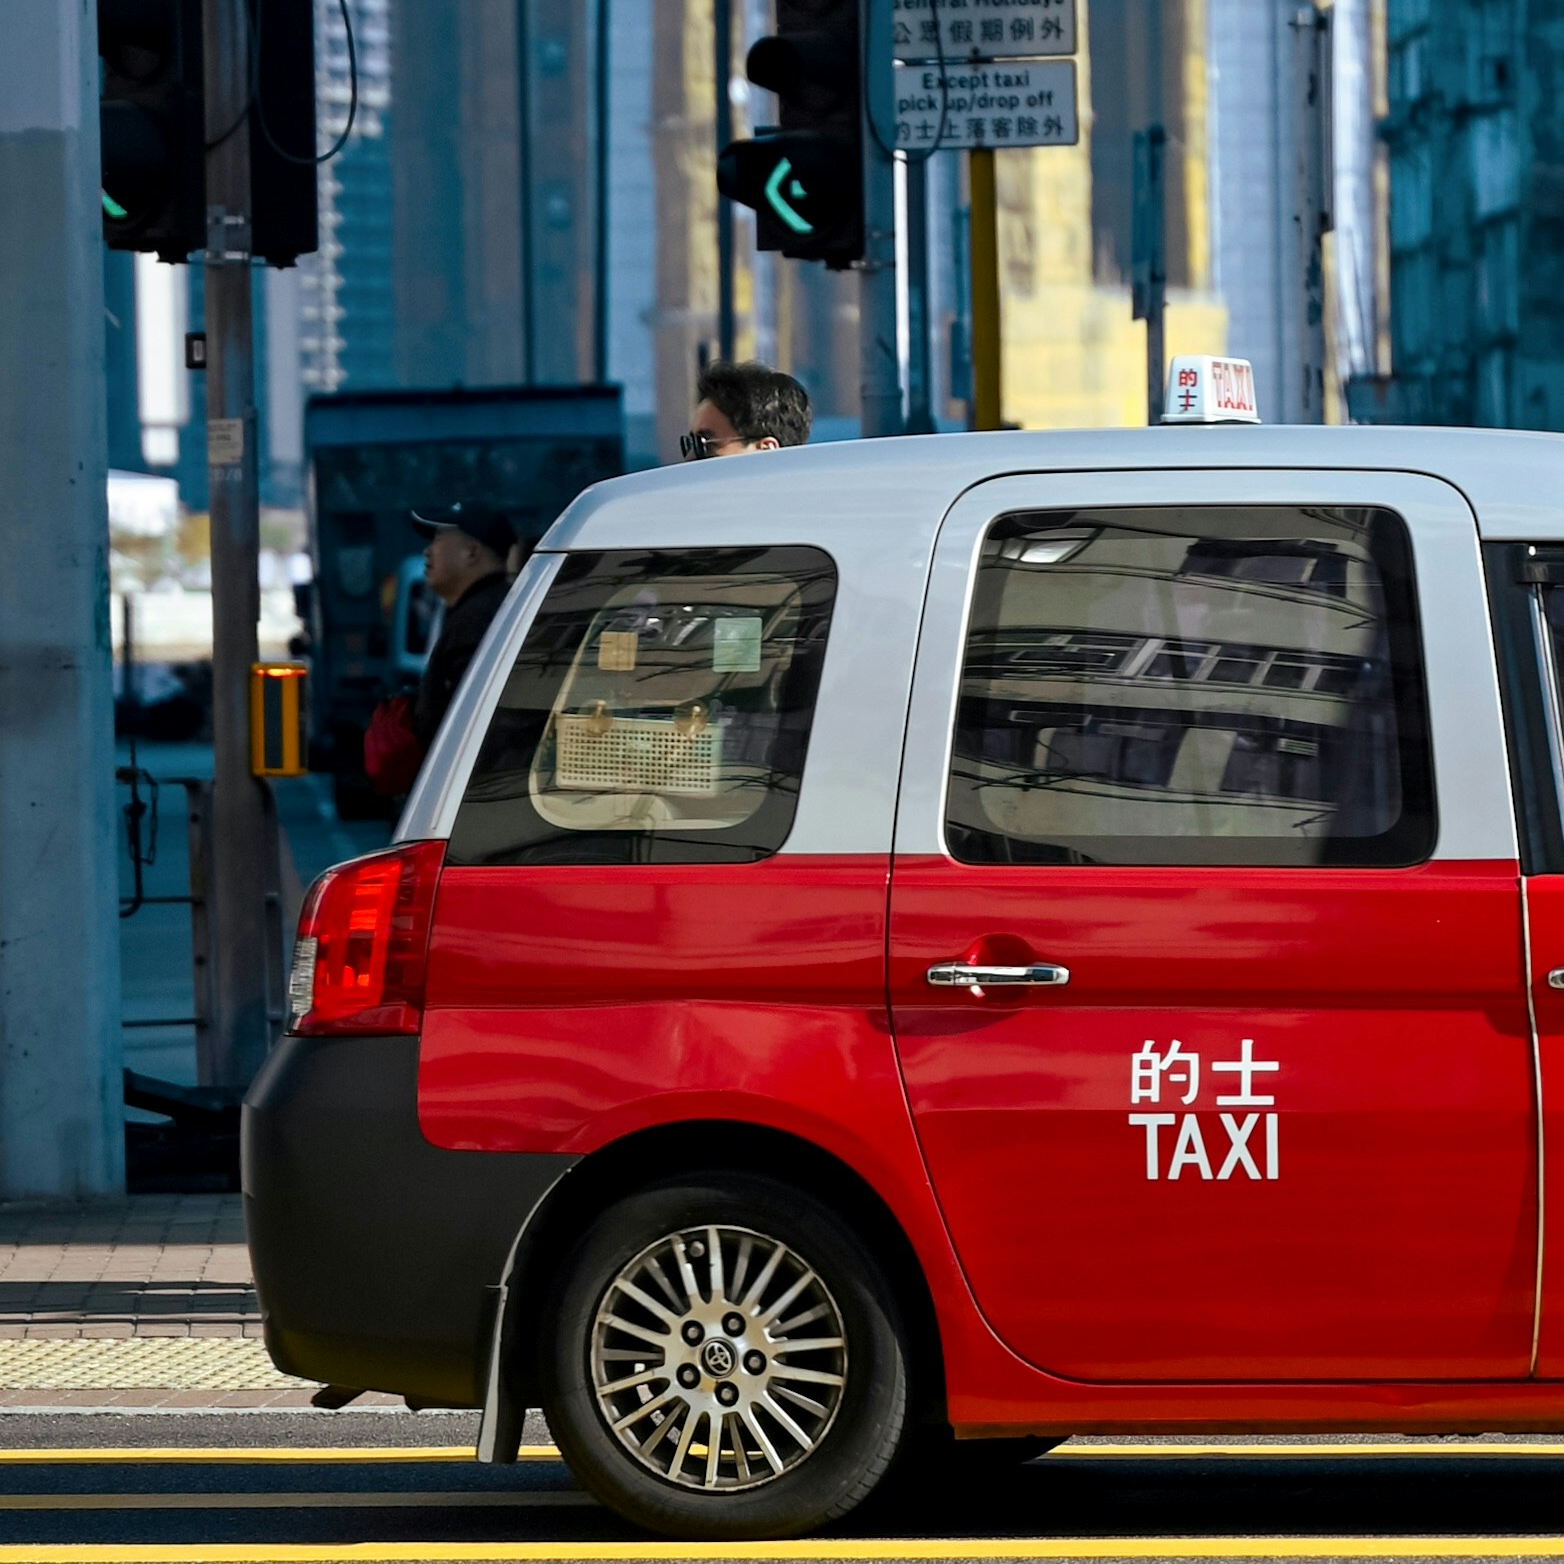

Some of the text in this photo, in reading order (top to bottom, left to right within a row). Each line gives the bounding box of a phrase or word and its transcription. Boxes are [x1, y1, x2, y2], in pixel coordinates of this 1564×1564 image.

[898, 94, 938, 114] pick
[1026, 91, 1054, 107] off
[922, 70, 1030, 91] Except taxi
[1177, 367, 1198, 412] 的士
[1211, 360, 1254, 412] TAXI
[1131, 1039, 1280, 1106] 的士
[1128, 1113, 1279, 1180] TAXI
